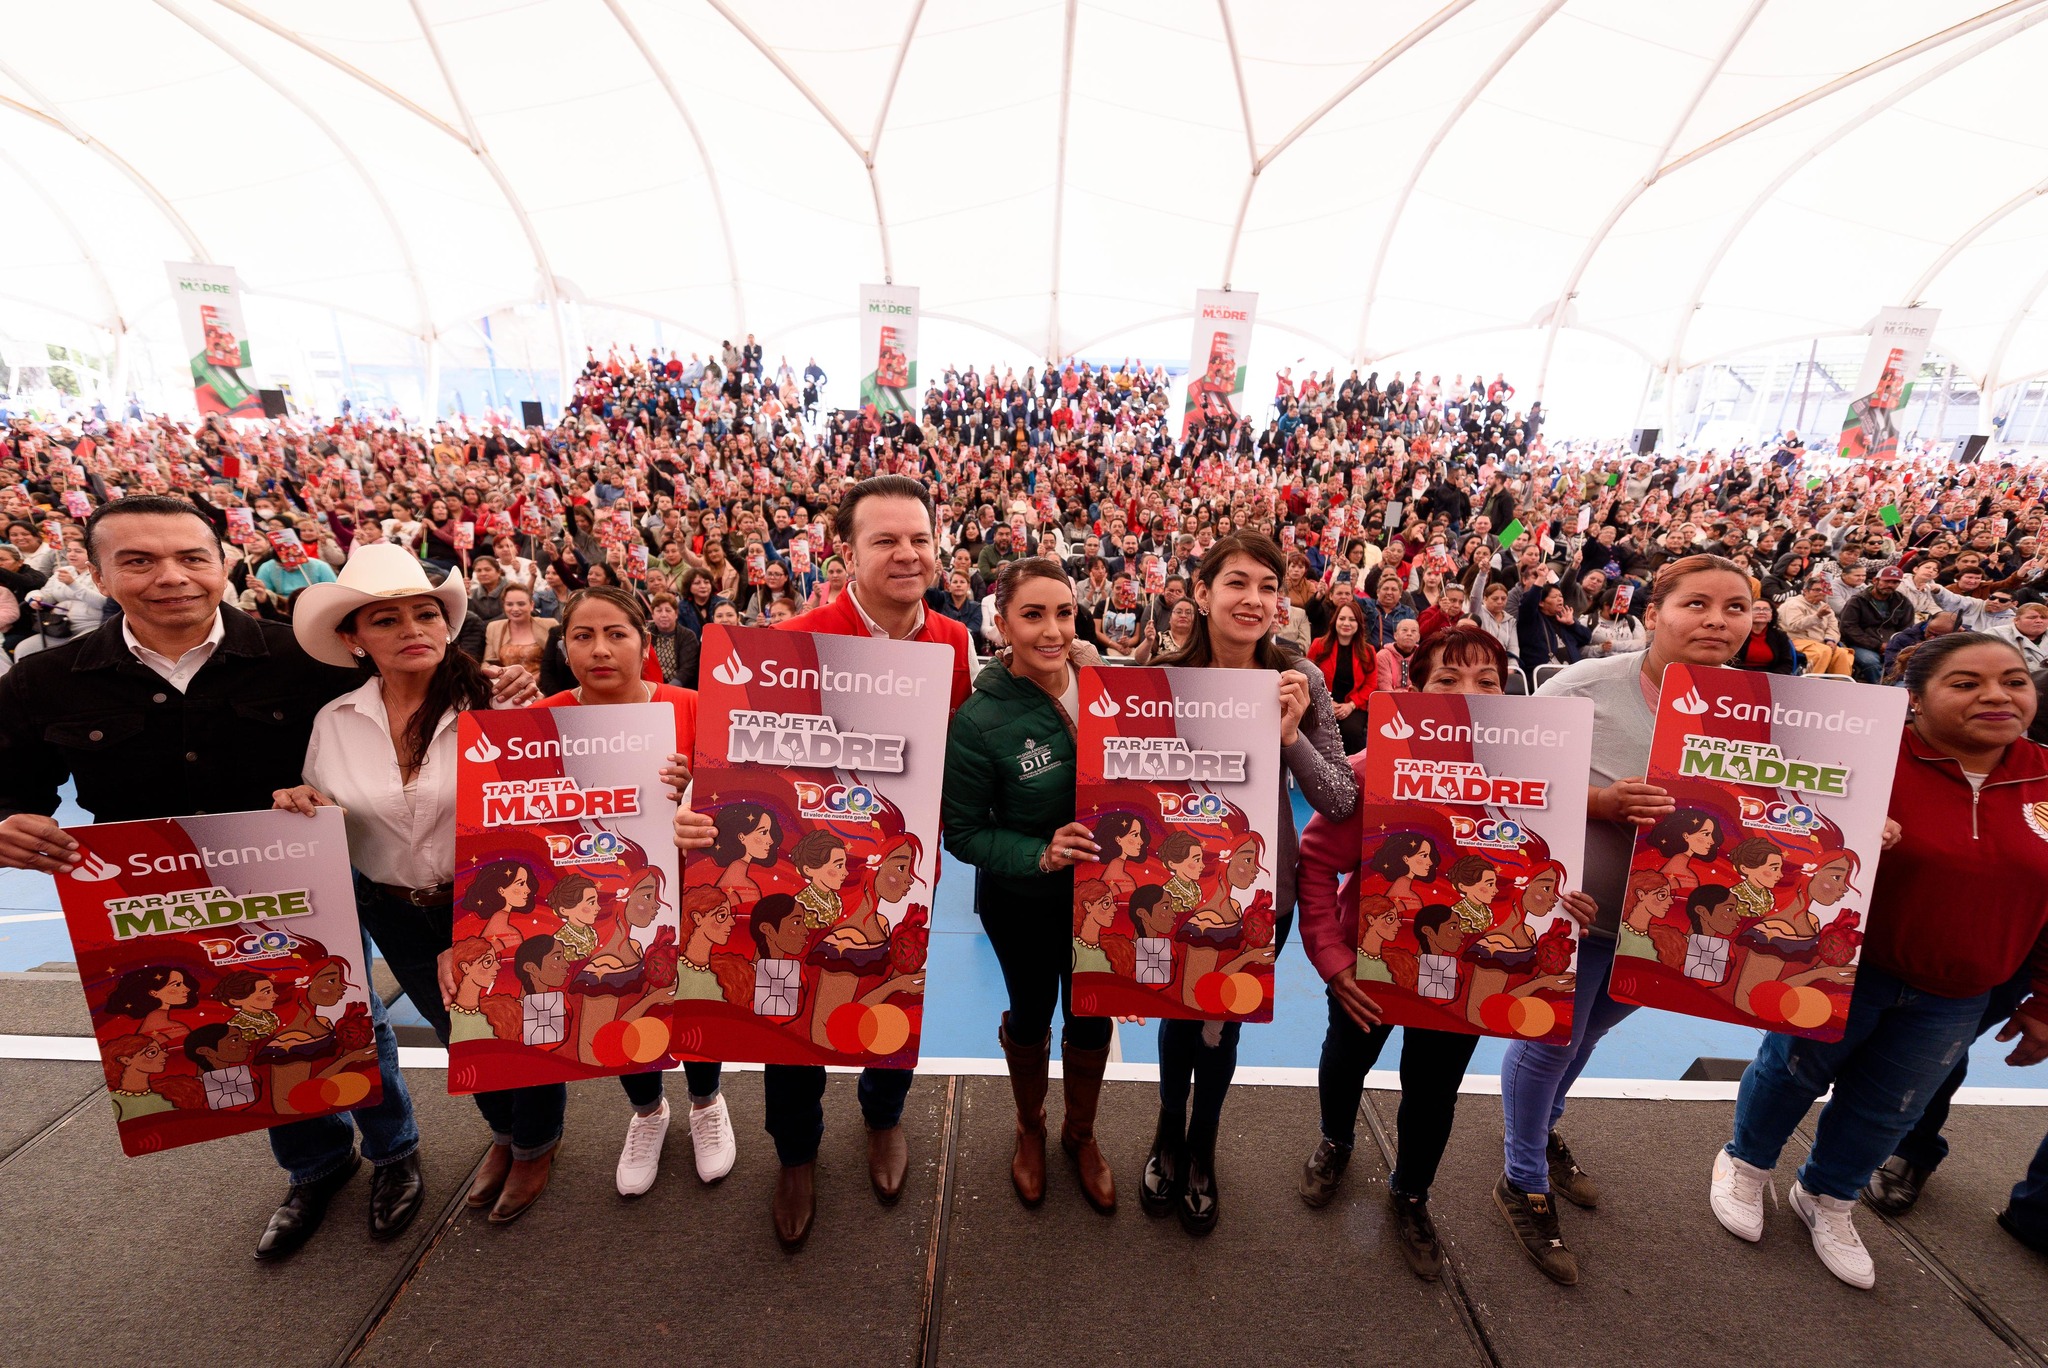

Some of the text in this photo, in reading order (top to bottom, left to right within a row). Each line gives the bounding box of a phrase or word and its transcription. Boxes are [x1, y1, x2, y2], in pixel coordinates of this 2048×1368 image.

[869, 304, 912, 315] MADRE
[1203, 309, 1247, 320] MADRE
[760, 660, 927, 696] Santander
[1125, 696, 1261, 718] Santander
[1714, 695, 1878, 735] Santander
[734, 714, 834, 732] TARJETA
[1419, 719, 1570, 747] Santander
[507, 730, 654, 761] Santander
[731, 730, 901, 769] MADRE
[1108, 740, 1186, 751] TARJETA
[1688, 737, 1780, 759] TARJETA
[1021, 751, 1051, 773] DIF
[1106, 752, 1243, 778] MADRE
[1398, 762, 1483, 776] TARJETA
[1683, 750, 1847, 794] MADRE
[487, 780, 575, 795] TARJETA
[1396, 774, 1546, 806] MADRE
[487, 788, 637, 824] MADRE
[129, 840, 320, 876] Santander
[112, 889, 228, 912] TARJETA
[113, 891, 309, 938] MADRE
